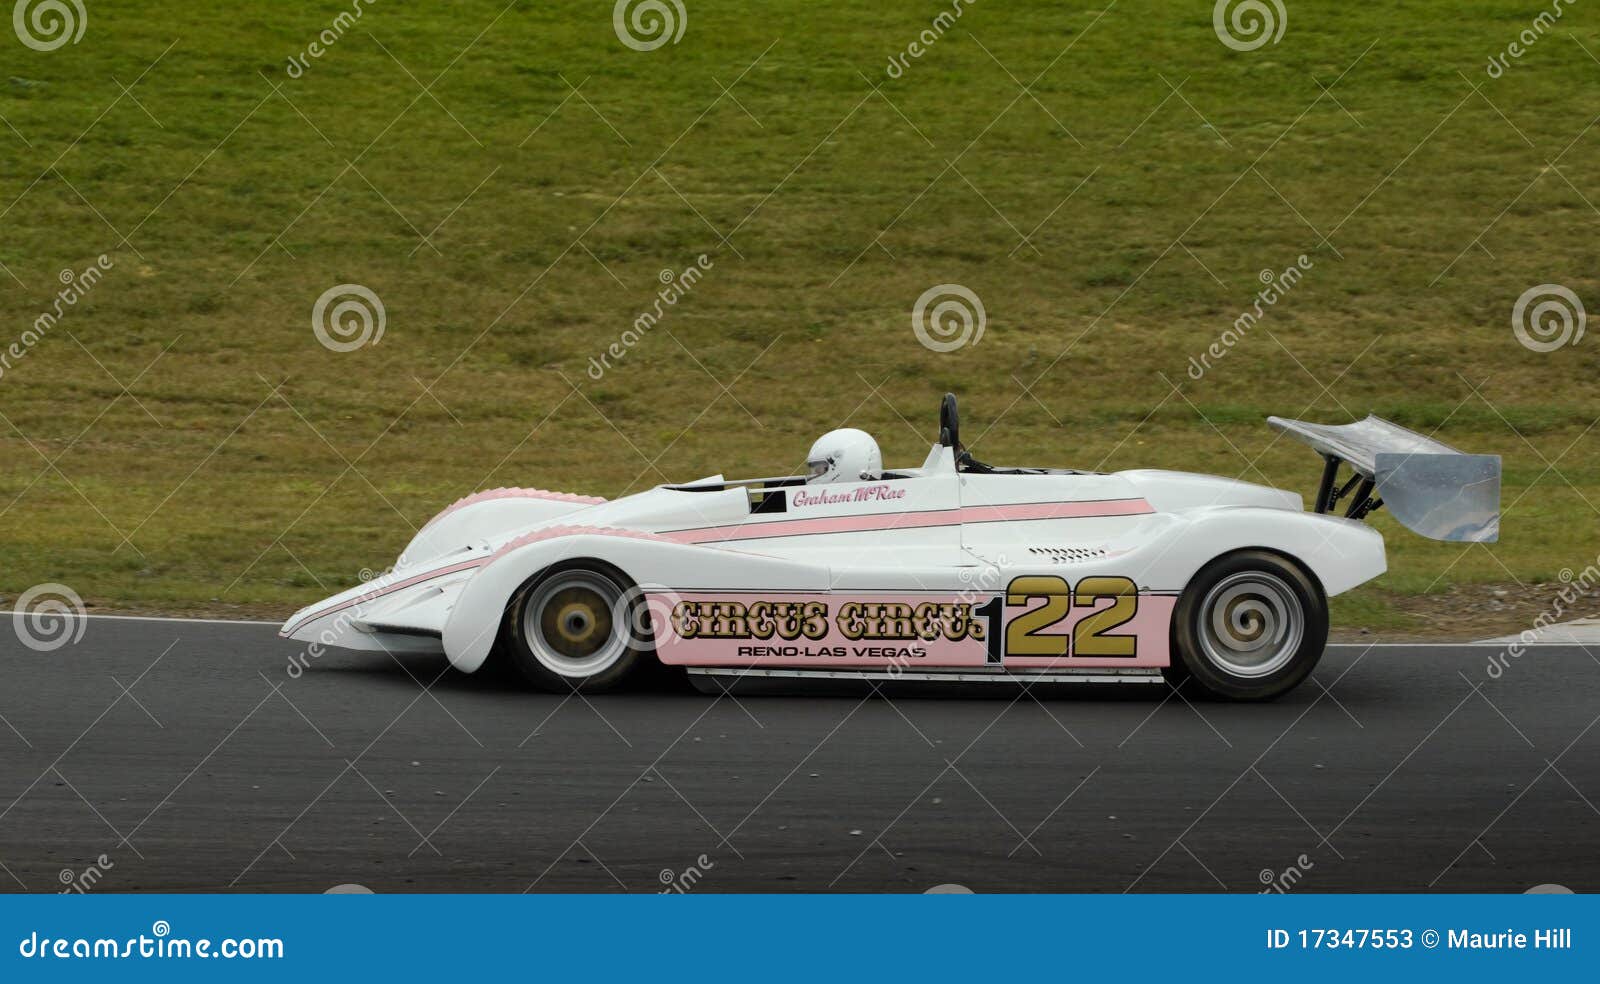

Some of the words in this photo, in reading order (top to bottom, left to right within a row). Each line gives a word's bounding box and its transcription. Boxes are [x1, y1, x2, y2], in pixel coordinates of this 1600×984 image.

[793, 489, 852, 507] Graham
[853, 484, 906, 501] McRae
[670, 600, 828, 641] CIRCUS
[738, 646, 847, 658] RENO-LAS
[852, 646, 927, 658] VEGAS
